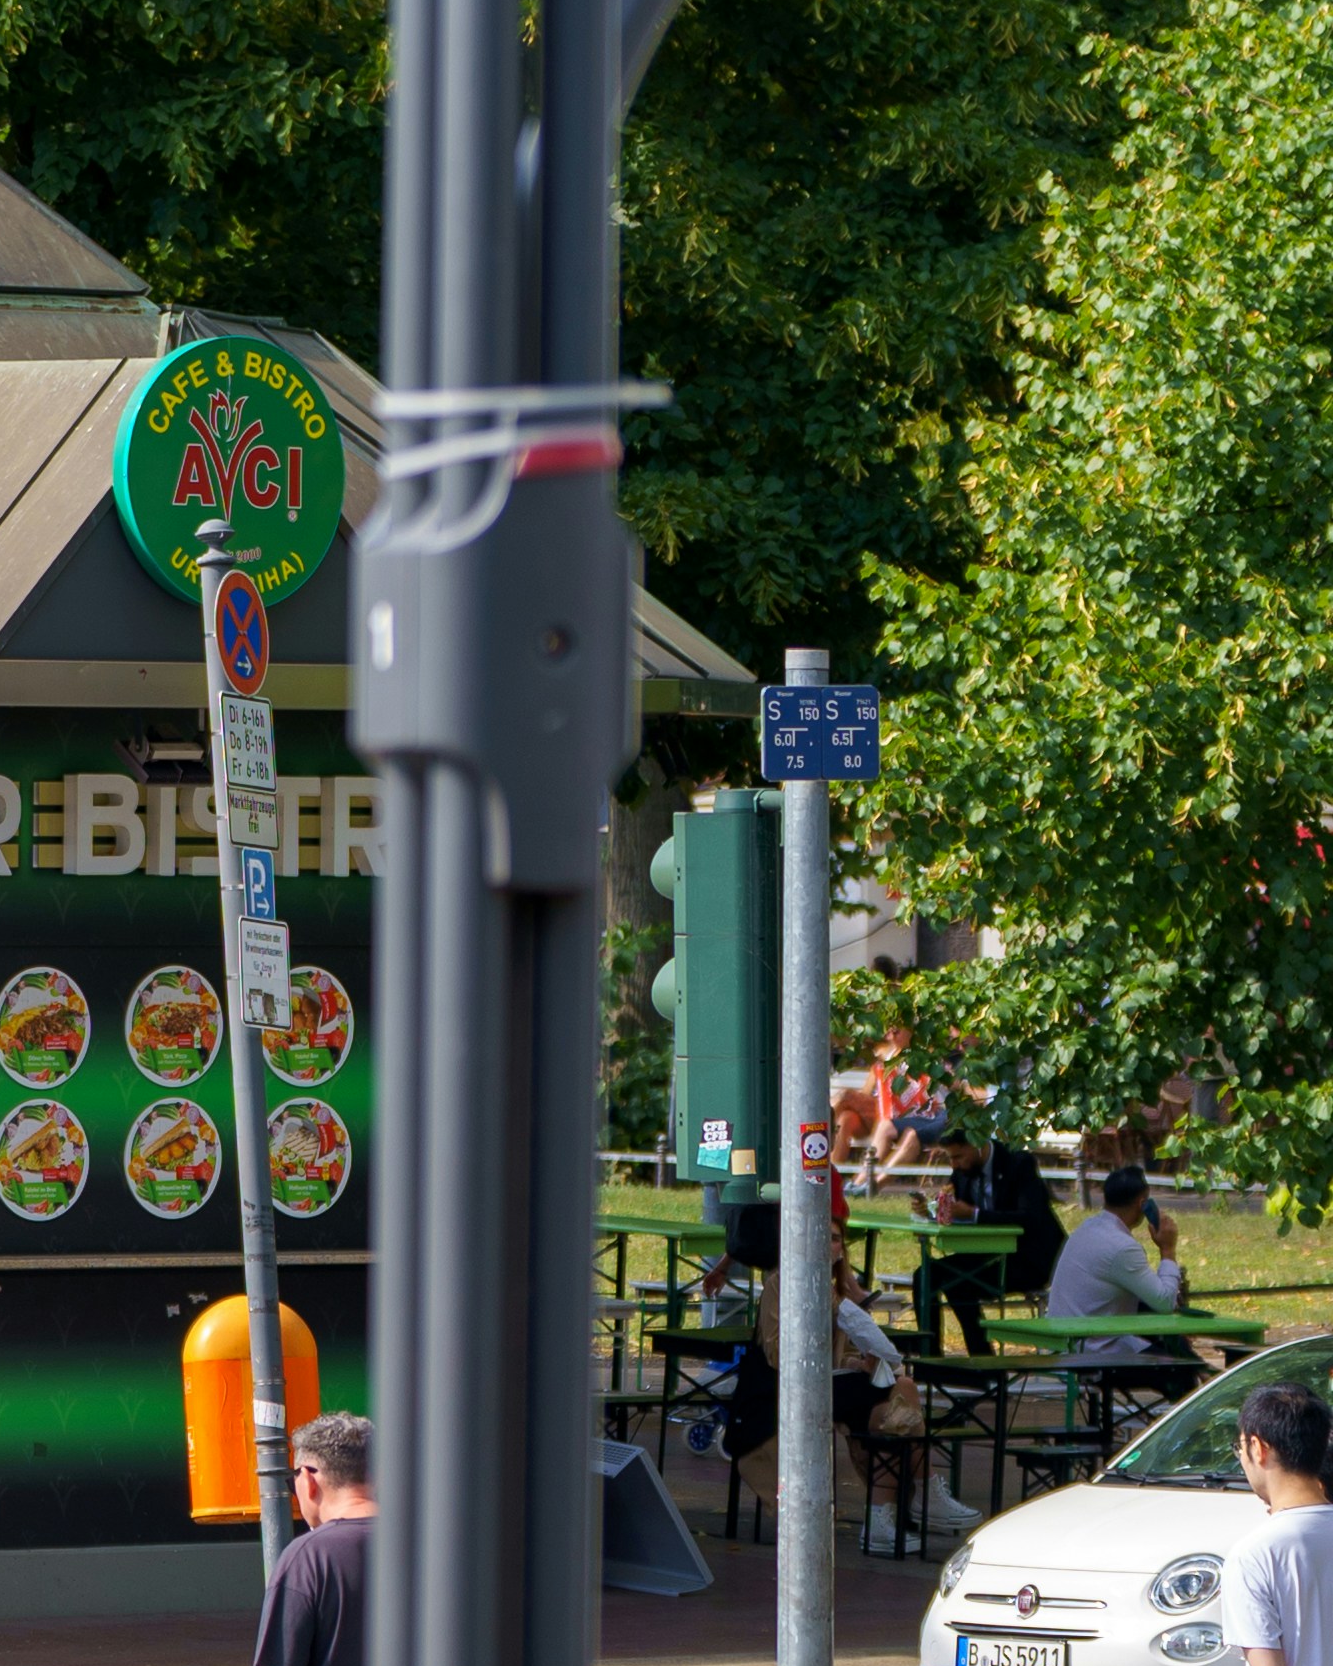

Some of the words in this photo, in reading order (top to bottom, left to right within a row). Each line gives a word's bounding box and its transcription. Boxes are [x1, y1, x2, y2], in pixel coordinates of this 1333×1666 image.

[148, 359, 210, 434] CAFE
[215, 350, 235, 378] &
[244, 351, 327, 440] BISTRO
[229, 704, 239, 725] Di
[242, 707, 265, 728] 6-16h
[768, 700, 781, 721] S
[799, 707, 820, 721] 150
[825, 699, 839, 720] S
[856, 706, 877, 720] 150
[230, 730, 242, 751] Do
[244, 734, 269, 755] 8-19h
[232, 758, 242, 777] Fr
[246, 760, 270, 782] 6-18h
